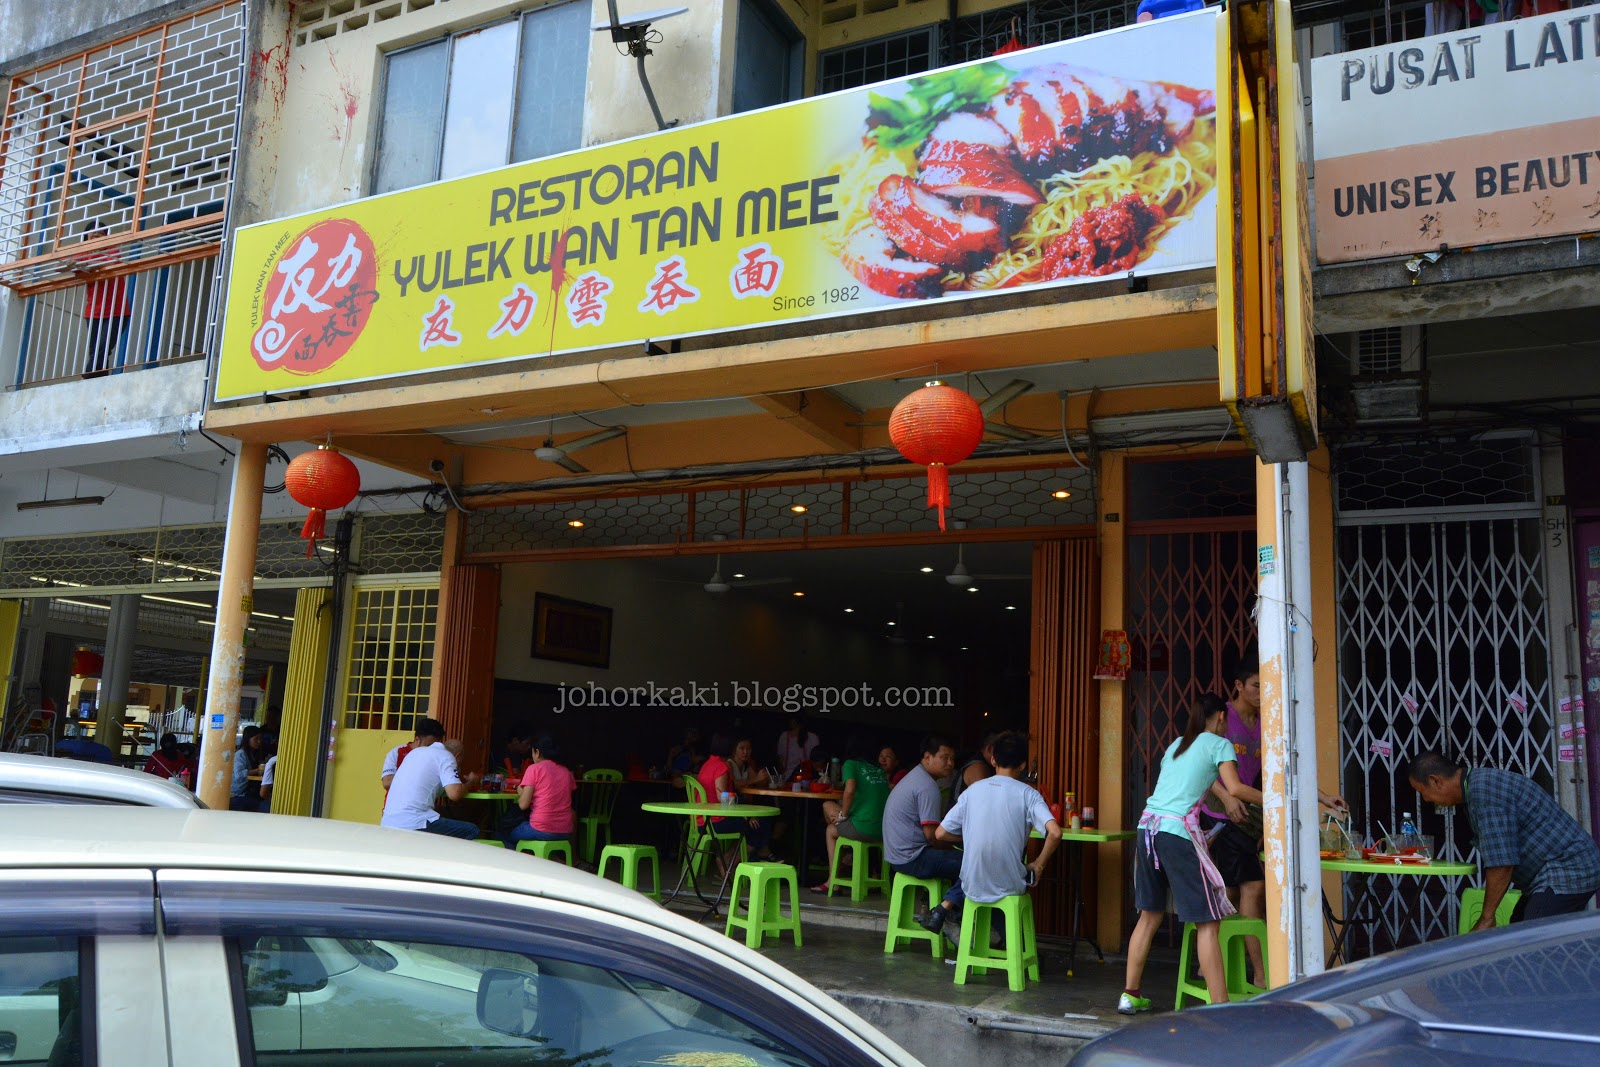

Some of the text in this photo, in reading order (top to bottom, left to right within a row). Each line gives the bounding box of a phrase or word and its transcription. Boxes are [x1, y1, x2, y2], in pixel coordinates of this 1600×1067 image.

[1341, 35, 1481, 101] PUSAT
[489, 141, 720, 227] RESTORAN
[1334, 171, 1456, 218] UNISEX
[394, 175, 841, 297] YULEK WAN TAN MEE
[251, 231, 291, 328] YULEK WAN TAN MEE
[270, 232, 362, 319] 友力
[772, 285, 860, 311] Since 1982
[1546, 517, 1566, 530] SH
[1552, 532, 1562, 548] 3
